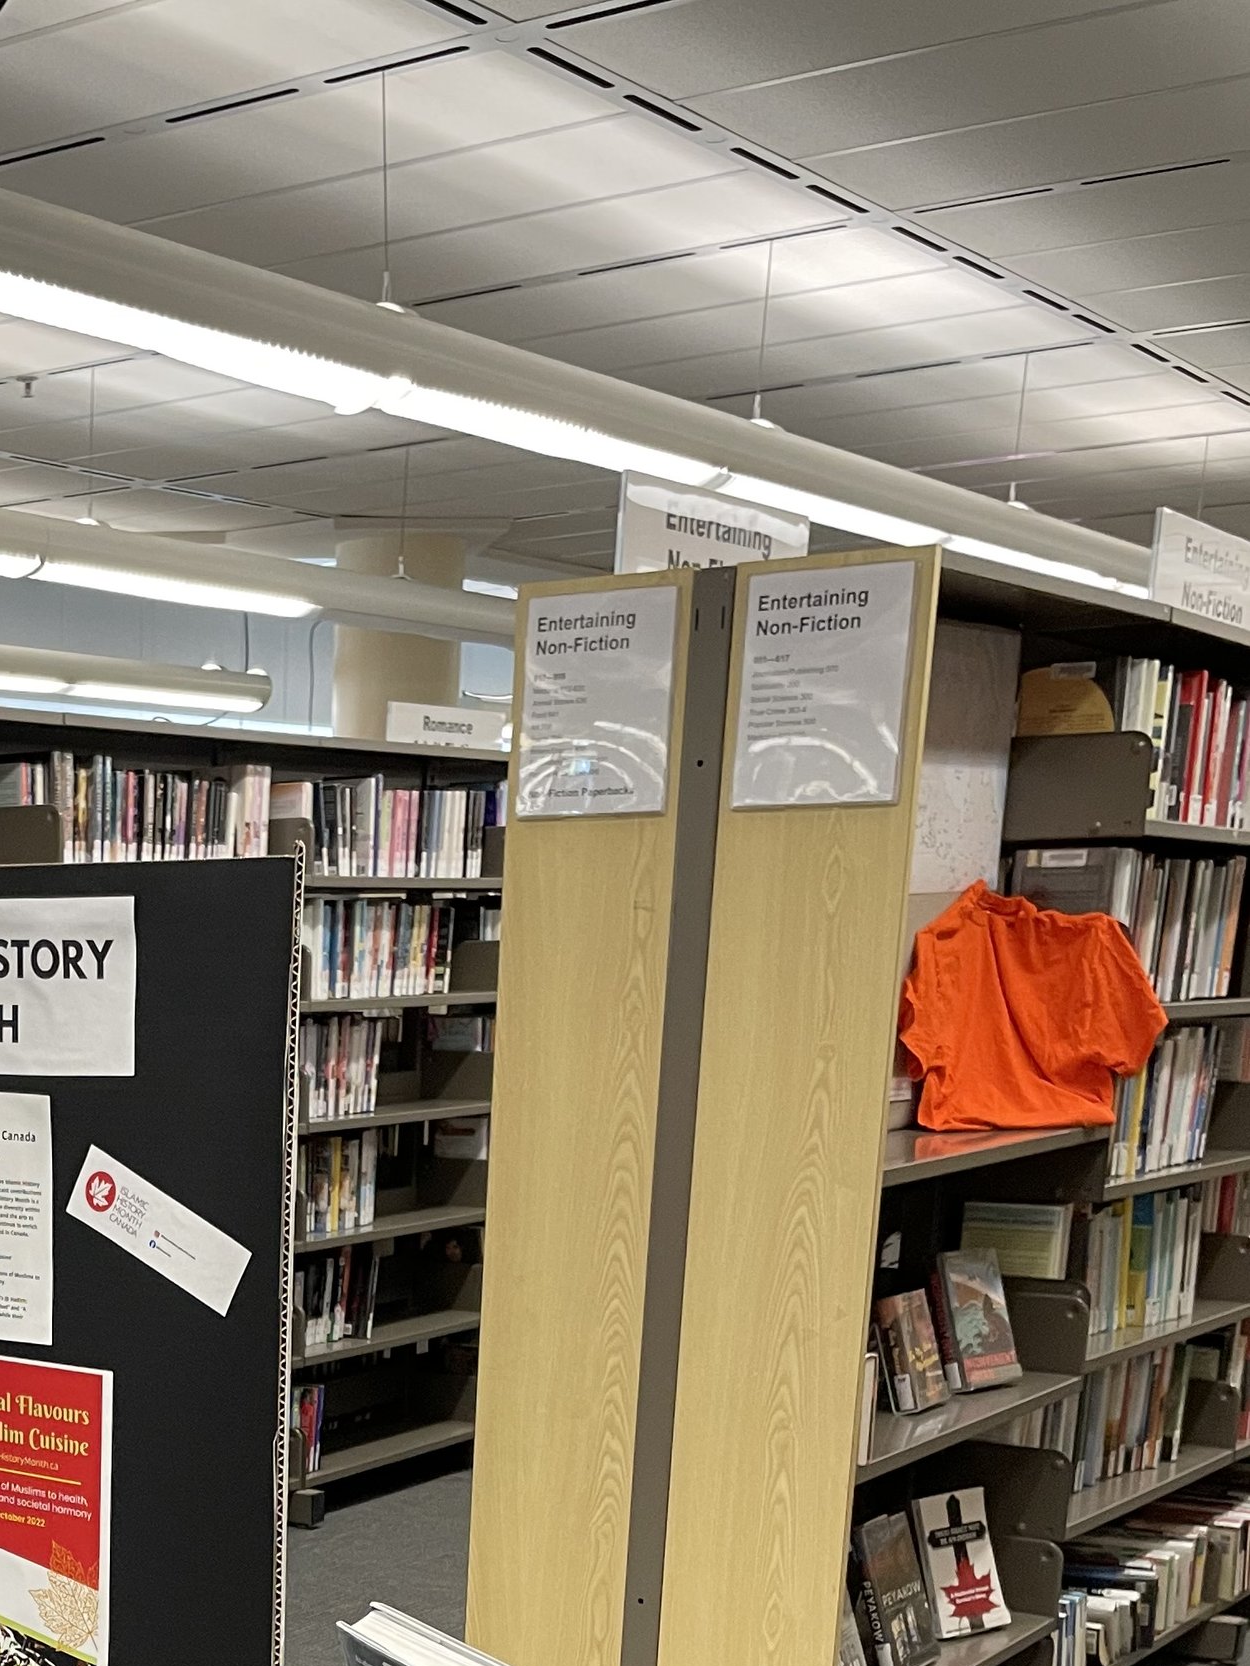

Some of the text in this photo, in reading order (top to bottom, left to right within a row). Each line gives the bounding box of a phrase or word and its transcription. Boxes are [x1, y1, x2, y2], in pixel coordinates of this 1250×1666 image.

[758, 589, 868, 611] Entertaining
[1181, 581, 1242, 624] Non-Fiction
[537, 611, 636, 632] Entertaining
[756, 614, 861, 636] Non-Fiction
[536, 636, 629, 655] Non-Fiction
[423, 715, 473, 734] Romance
[2, 1130, 36, 1142] Canada
[117, 1196, 146, 1219] HISTORY
[120, 1186, 149, 1211] ISLAMIC
[110, 1214, 137, 1238] CANADA
[114, 1205, 142, 1229] MONTH
[15, 1394, 89, 1425] Flavours
[29, 1428, 89, 1456] Cuisine
[1, 1481, 9, 1491] of
[11, 1482, 46, 1498] Muslims
[48, 1490, 56, 1500] to
[17, 1496, 50, 1512] societal
[52, 1502, 92, 1521] harmony
[27, 1514, 46, 1528] 2022
[882, 1580, 921, 1606] PEYAKOW
[862, 1581, 885, 1642] PEYAKOW
